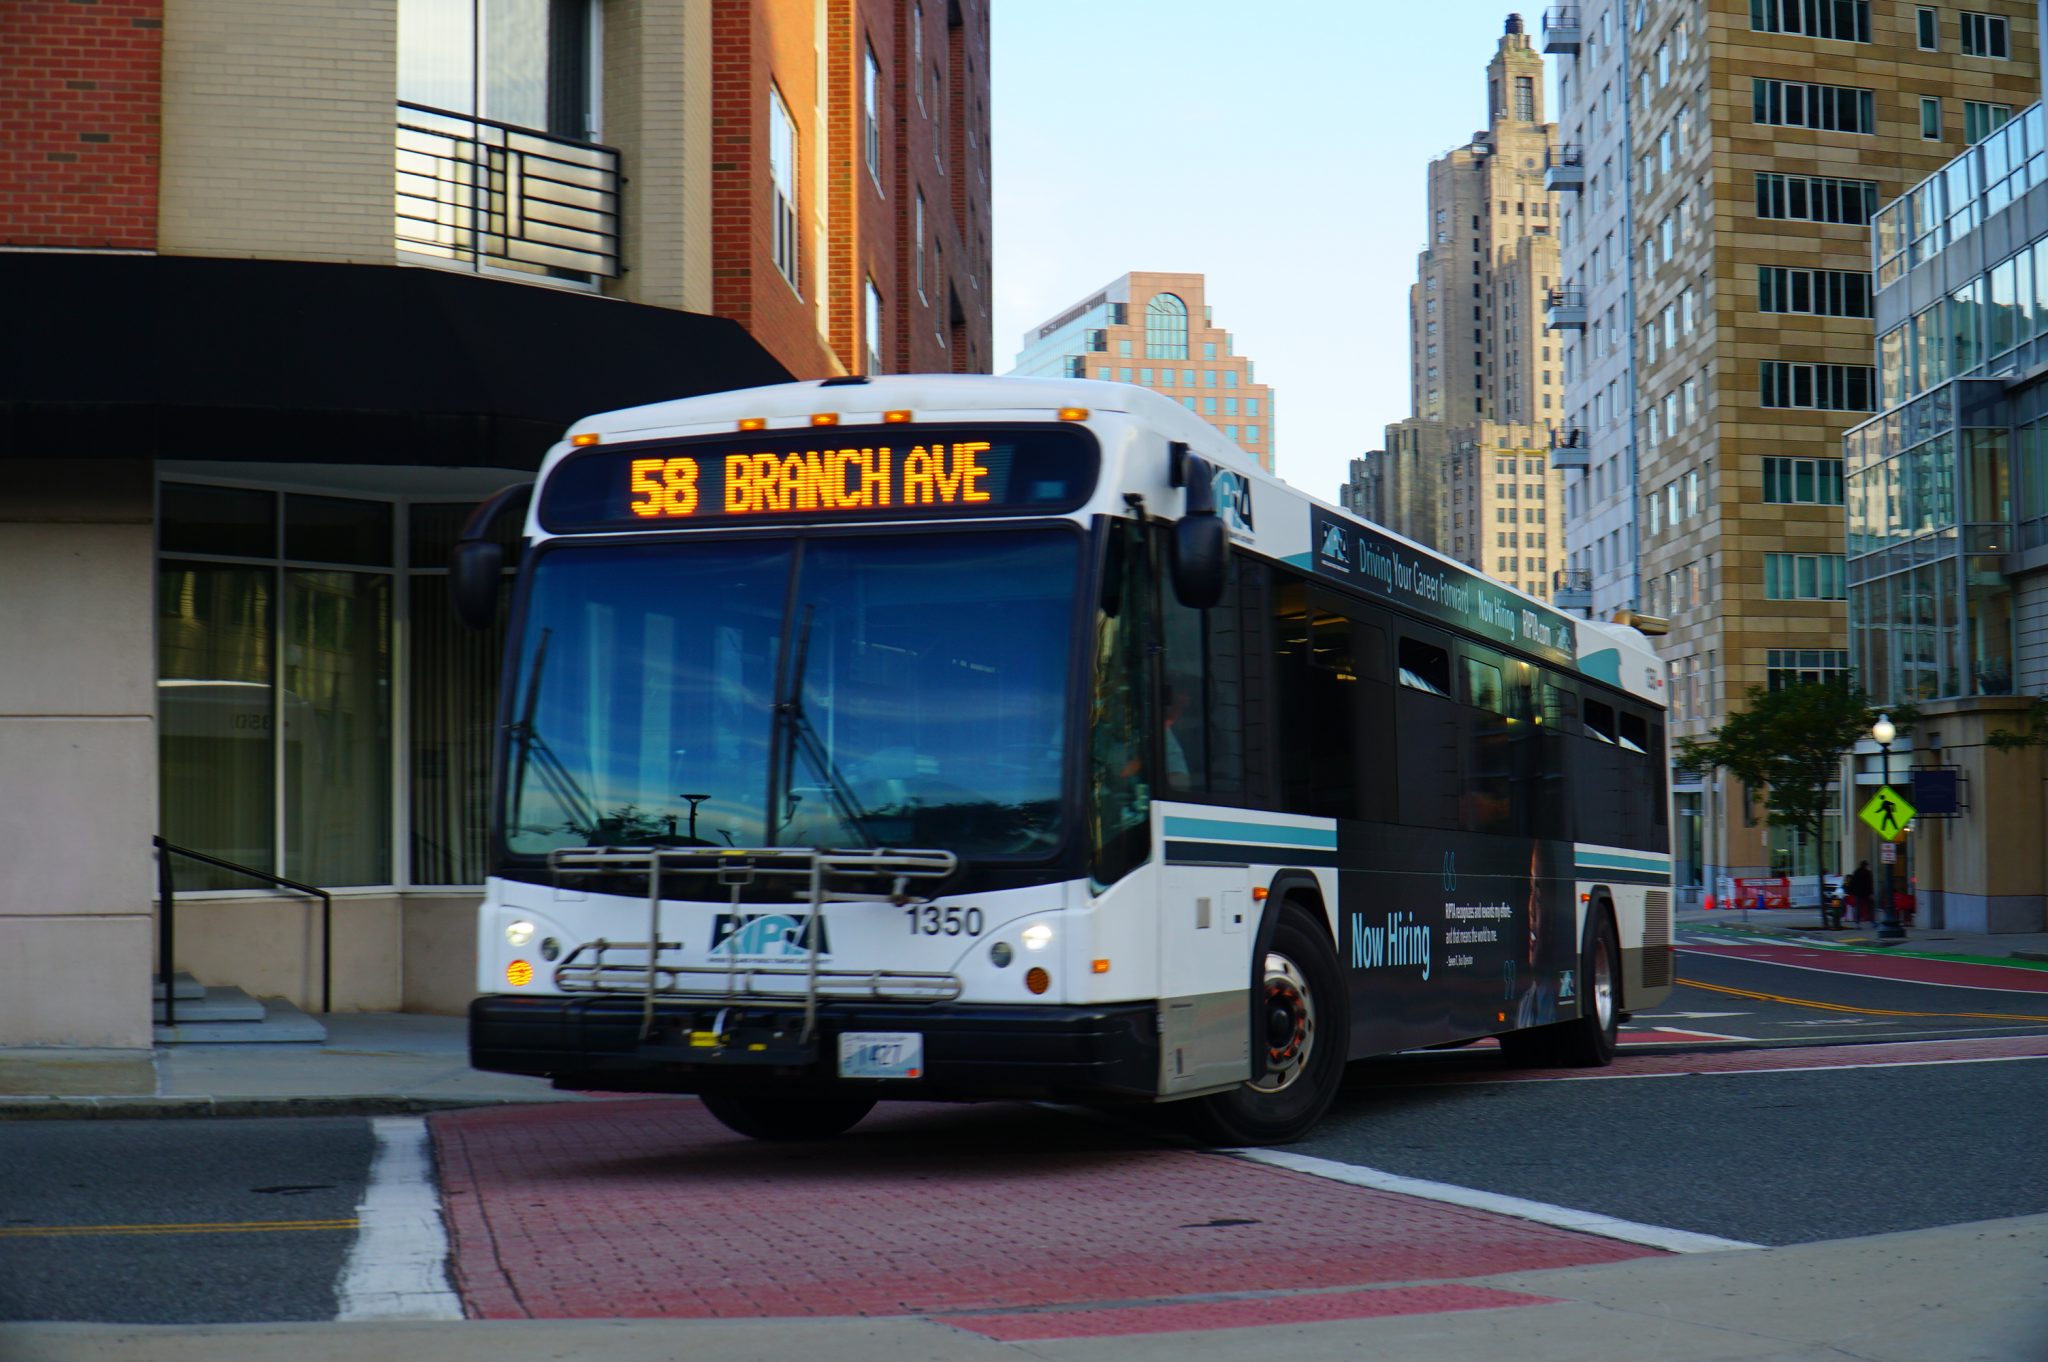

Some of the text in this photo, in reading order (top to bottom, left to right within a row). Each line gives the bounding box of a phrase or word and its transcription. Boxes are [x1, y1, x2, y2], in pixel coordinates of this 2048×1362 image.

[632, 442, 991, 516] 58 BRANCH AVE
[1359, 538, 1469, 615] Driving Your Career Forward
[1478, 589, 1515, 641] Now Hiring
[1522, 608, 1552, 647] RIPTA.com
[905, 905, 984, 937] 1350
[1352, 911, 1430, 981] Now Hiring
